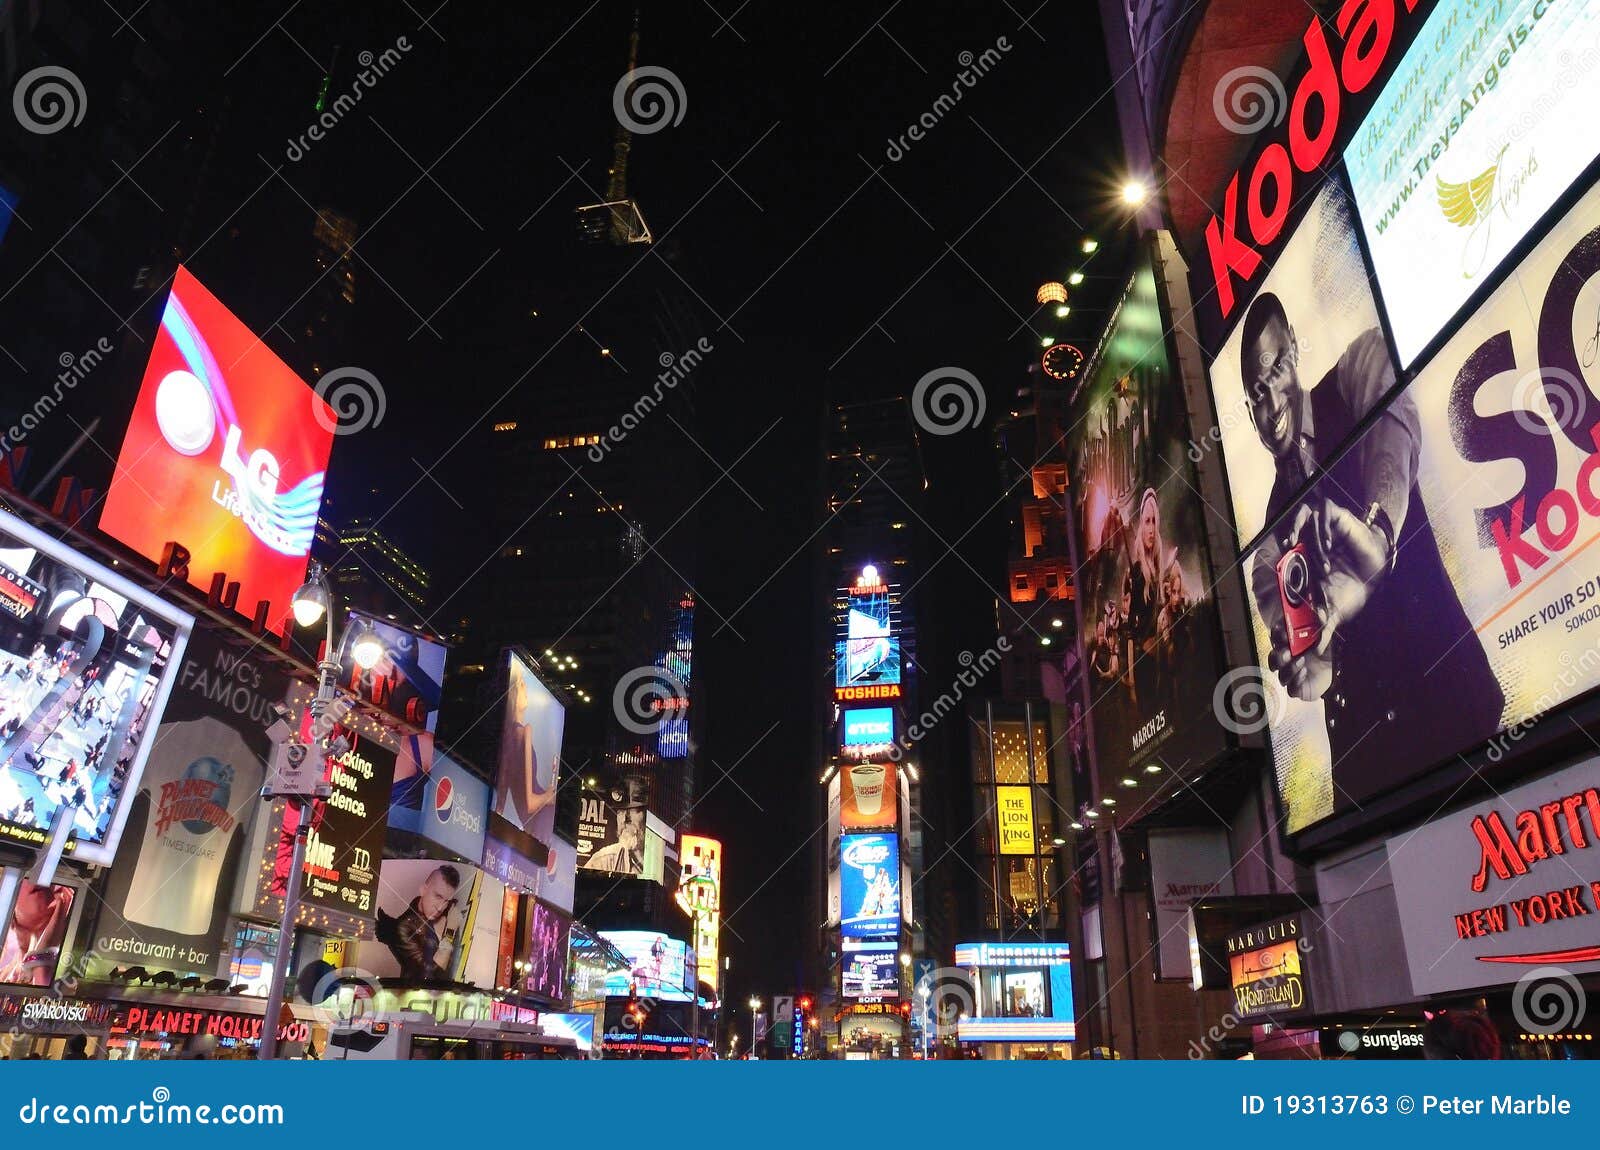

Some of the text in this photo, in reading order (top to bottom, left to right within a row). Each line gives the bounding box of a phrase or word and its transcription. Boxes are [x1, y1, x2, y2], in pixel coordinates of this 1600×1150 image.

[1375, 0, 1555, 236] www.TreysAngels.c
[1205, 0, 1423, 319] Koda
[219, 423, 279, 502] LG
[848, 585, 888, 595] TOSHIBA
[1498, 614, 1539, 649] SHARE
[1539, 593, 1575, 624] YOUR
[1576, 580, 1595, 603] SO
[216, 649, 261, 688] NYC's
[180, 660, 276, 727] FAMOUS
[836, 685, 900, 700] TOSHIBA
[1132, 718, 1156, 751] MARCH
[1156, 710, 1166, 732] 25
[330, 765, 357, 792] New.
[157, 779, 219, 815] PLANET
[327, 789, 367, 818] dence.
[1005, 799, 1024, 808] THE
[452, 804, 481, 834] pepsi
[1002, 811, 1028, 827] LION
[1003, 829, 1031, 845] KING
[358, 894, 370, 911] 23
[1454, 903, 1507, 940] NEW
[1511, 886, 1588, 927] YORK
[107, 935, 177, 961] restaurant
[187, 946, 209, 965] bar
[1227, 919, 1297, 953] MARQUIS
[22, 1003, 88, 1021] SWAROVSKI
[1234, 976, 1303, 1018] WONDERLAND
[127, 1007, 203, 1034] PLANET
[206, 1015, 310, 1043] HOLLYOD
[1362, 1030, 1425, 1051] sunglass
